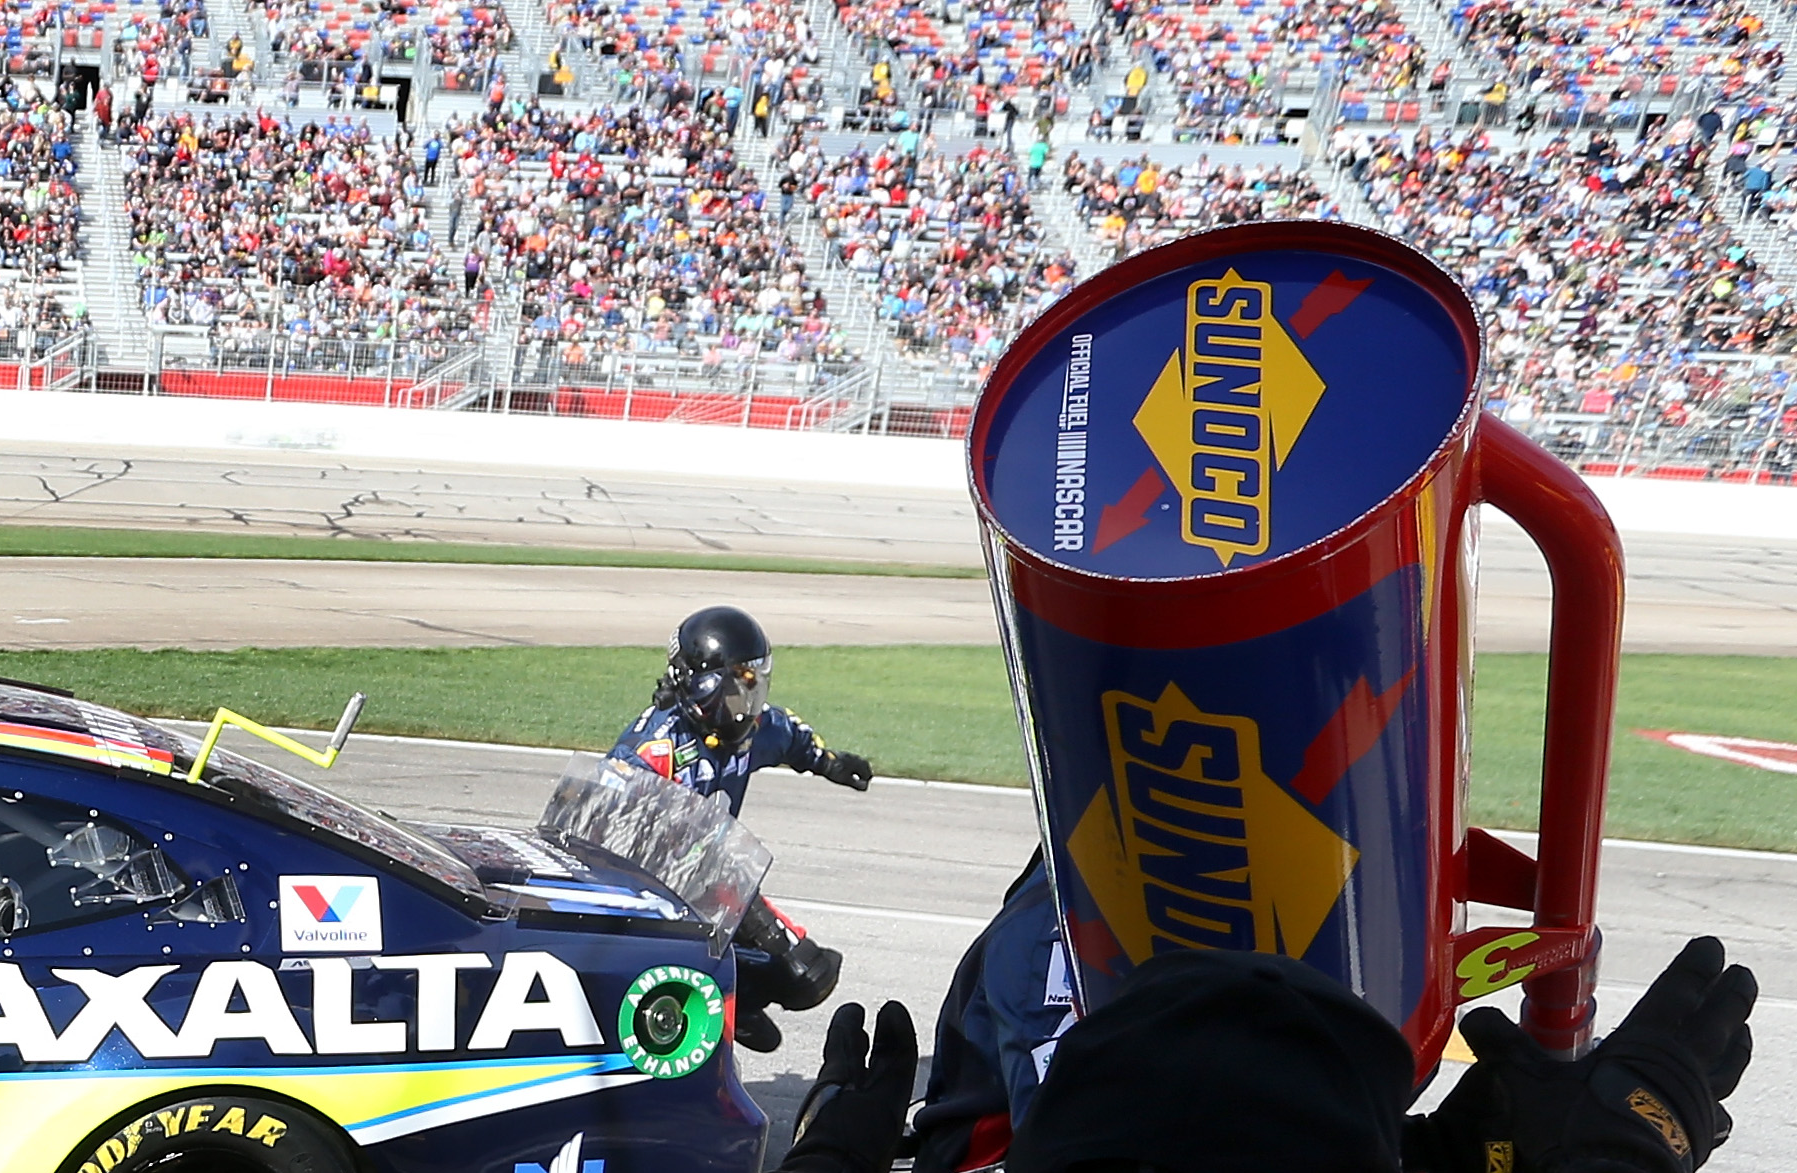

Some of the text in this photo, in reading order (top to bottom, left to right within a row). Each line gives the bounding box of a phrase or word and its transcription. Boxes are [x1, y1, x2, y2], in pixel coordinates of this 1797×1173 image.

[1067, 333, 1093, 431] OFFICIAL FUEL
[1190, 285, 1264, 546] SUNOCO
[1053, 459, 1086, 551] NASCAR
[1114, 698, 1260, 955] SUNO
[293, 928, 368, 942] Valvoline
[628, 966, 723, 1016] AMERICAN
[623, 1034, 716, 1078] ETHANOL
